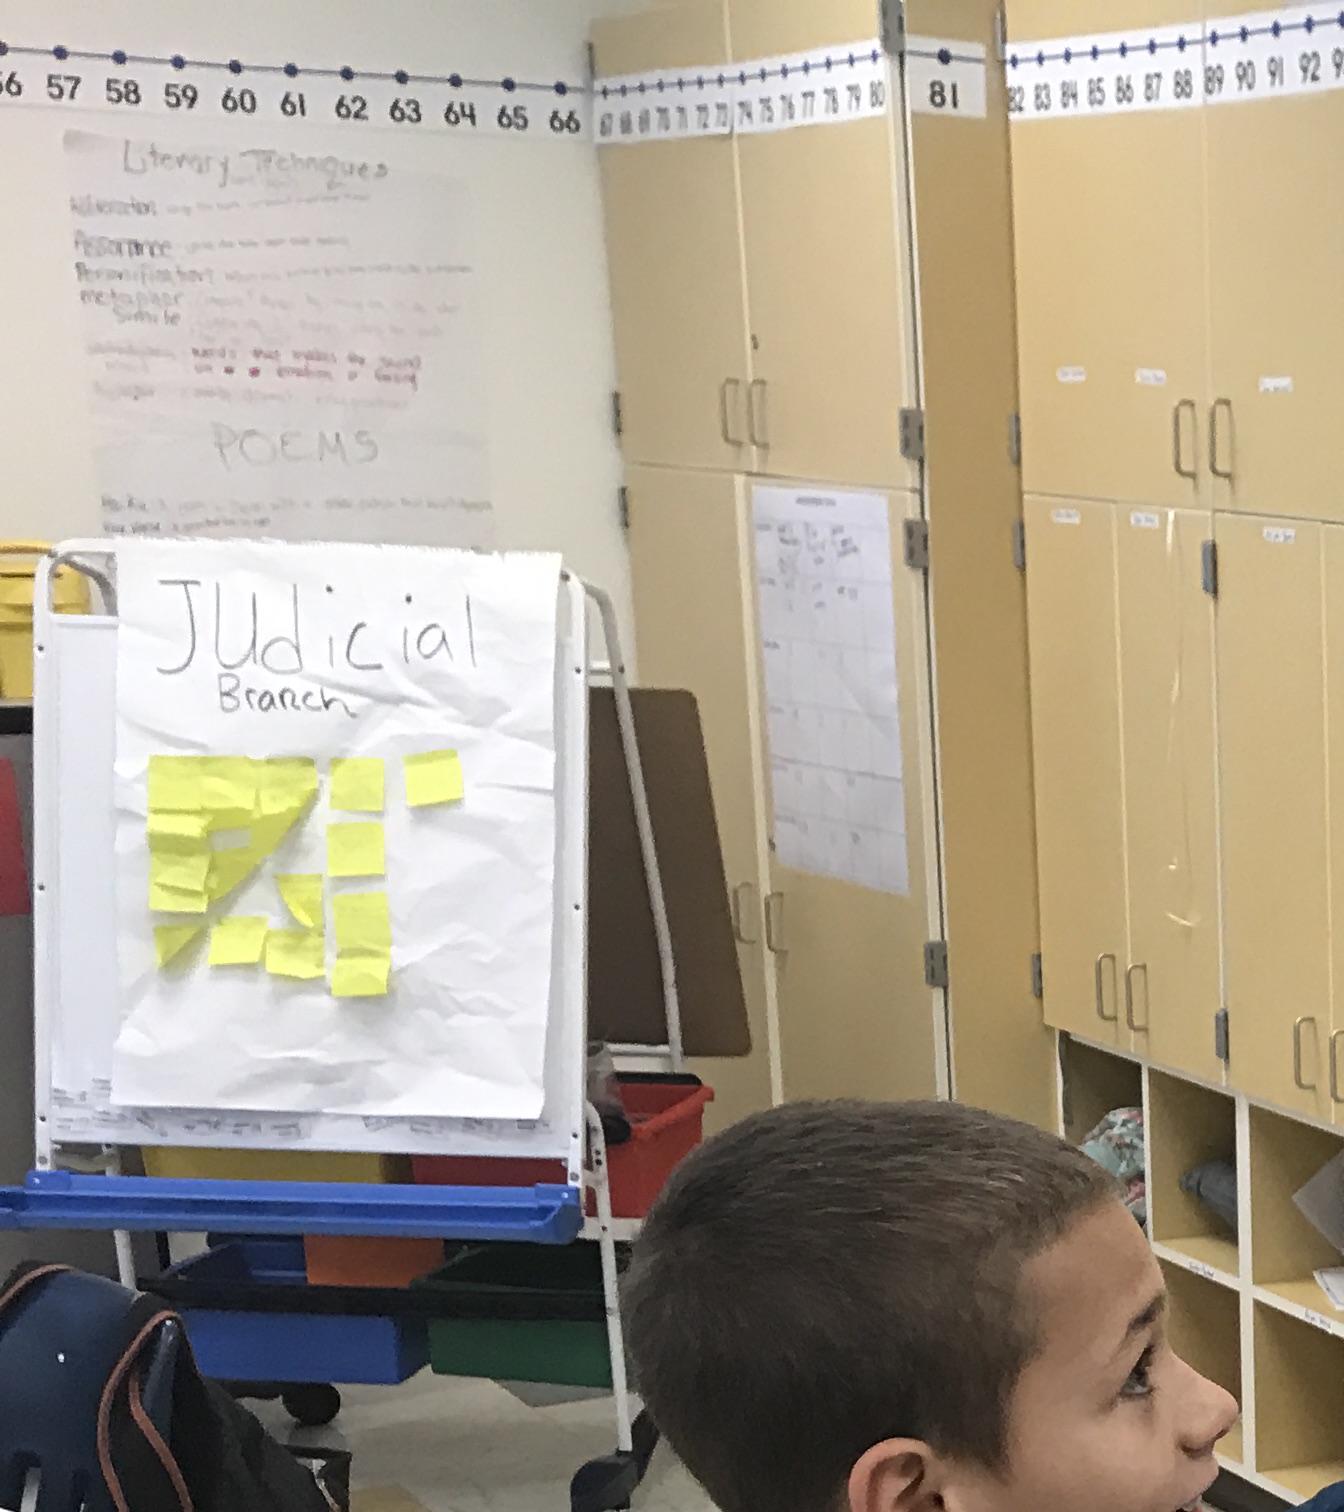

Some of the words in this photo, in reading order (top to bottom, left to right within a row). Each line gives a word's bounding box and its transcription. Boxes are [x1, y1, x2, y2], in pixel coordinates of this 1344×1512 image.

[47, 74, 82, 100] 57
[105, 77, 141, 106] 58
[164, 82, 199, 109] 59
[221, 87, 257, 113] 60
[280, 91, 306, 117] 61
[335, 95, 369, 121] 62
[389, 98, 422, 123] 63
[444, 101, 477, 127] 64
[497, 105, 529, 131] 65
[550, 109, 581, 134] 66
[929, 80, 959, 109] 81
[1034, 82, 1051, 111] 83
[1061, 80, 1078, 109] 84
[1087, 76, 1105, 106] 85
[1115, 74, 1134, 105] 86
[1144, 72, 1162, 103] 87
[1173, 68, 1193, 99] 88
[1204, 64, 1224, 96] 89
[1235, 59, 1256, 91] 90
[1267, 56, 1284, 87] 91
[1299, 51, 1321, 83] 92
[211, 421, 379, 470] POEMS
[218, 674, 358, 718] Branch
